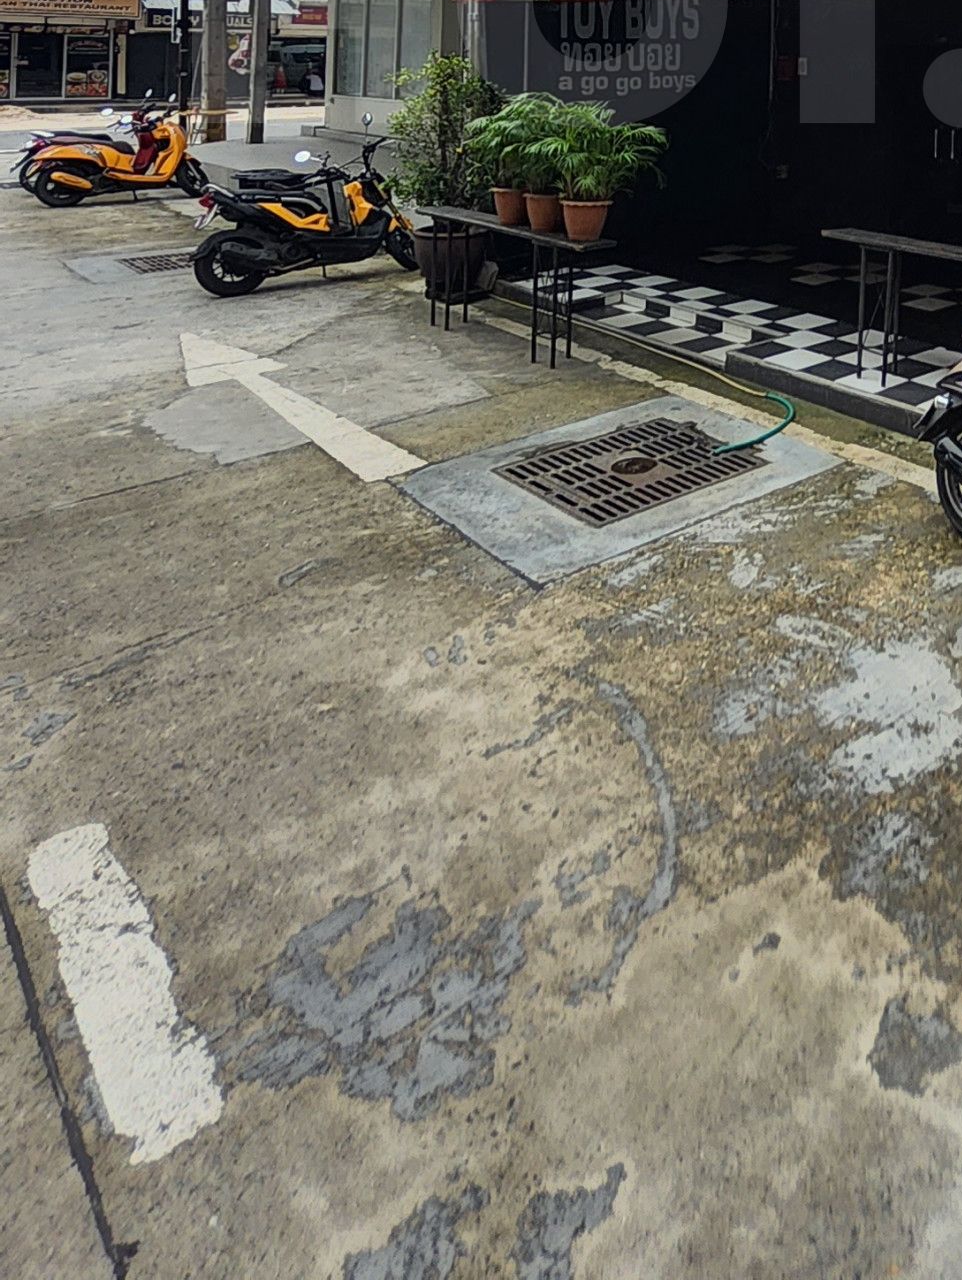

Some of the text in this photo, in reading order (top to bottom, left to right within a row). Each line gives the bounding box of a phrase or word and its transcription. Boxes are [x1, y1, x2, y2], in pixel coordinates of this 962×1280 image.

[54, 3, 131, 12] RESTAURANT
[558, 72, 696, 96] a go go boys
